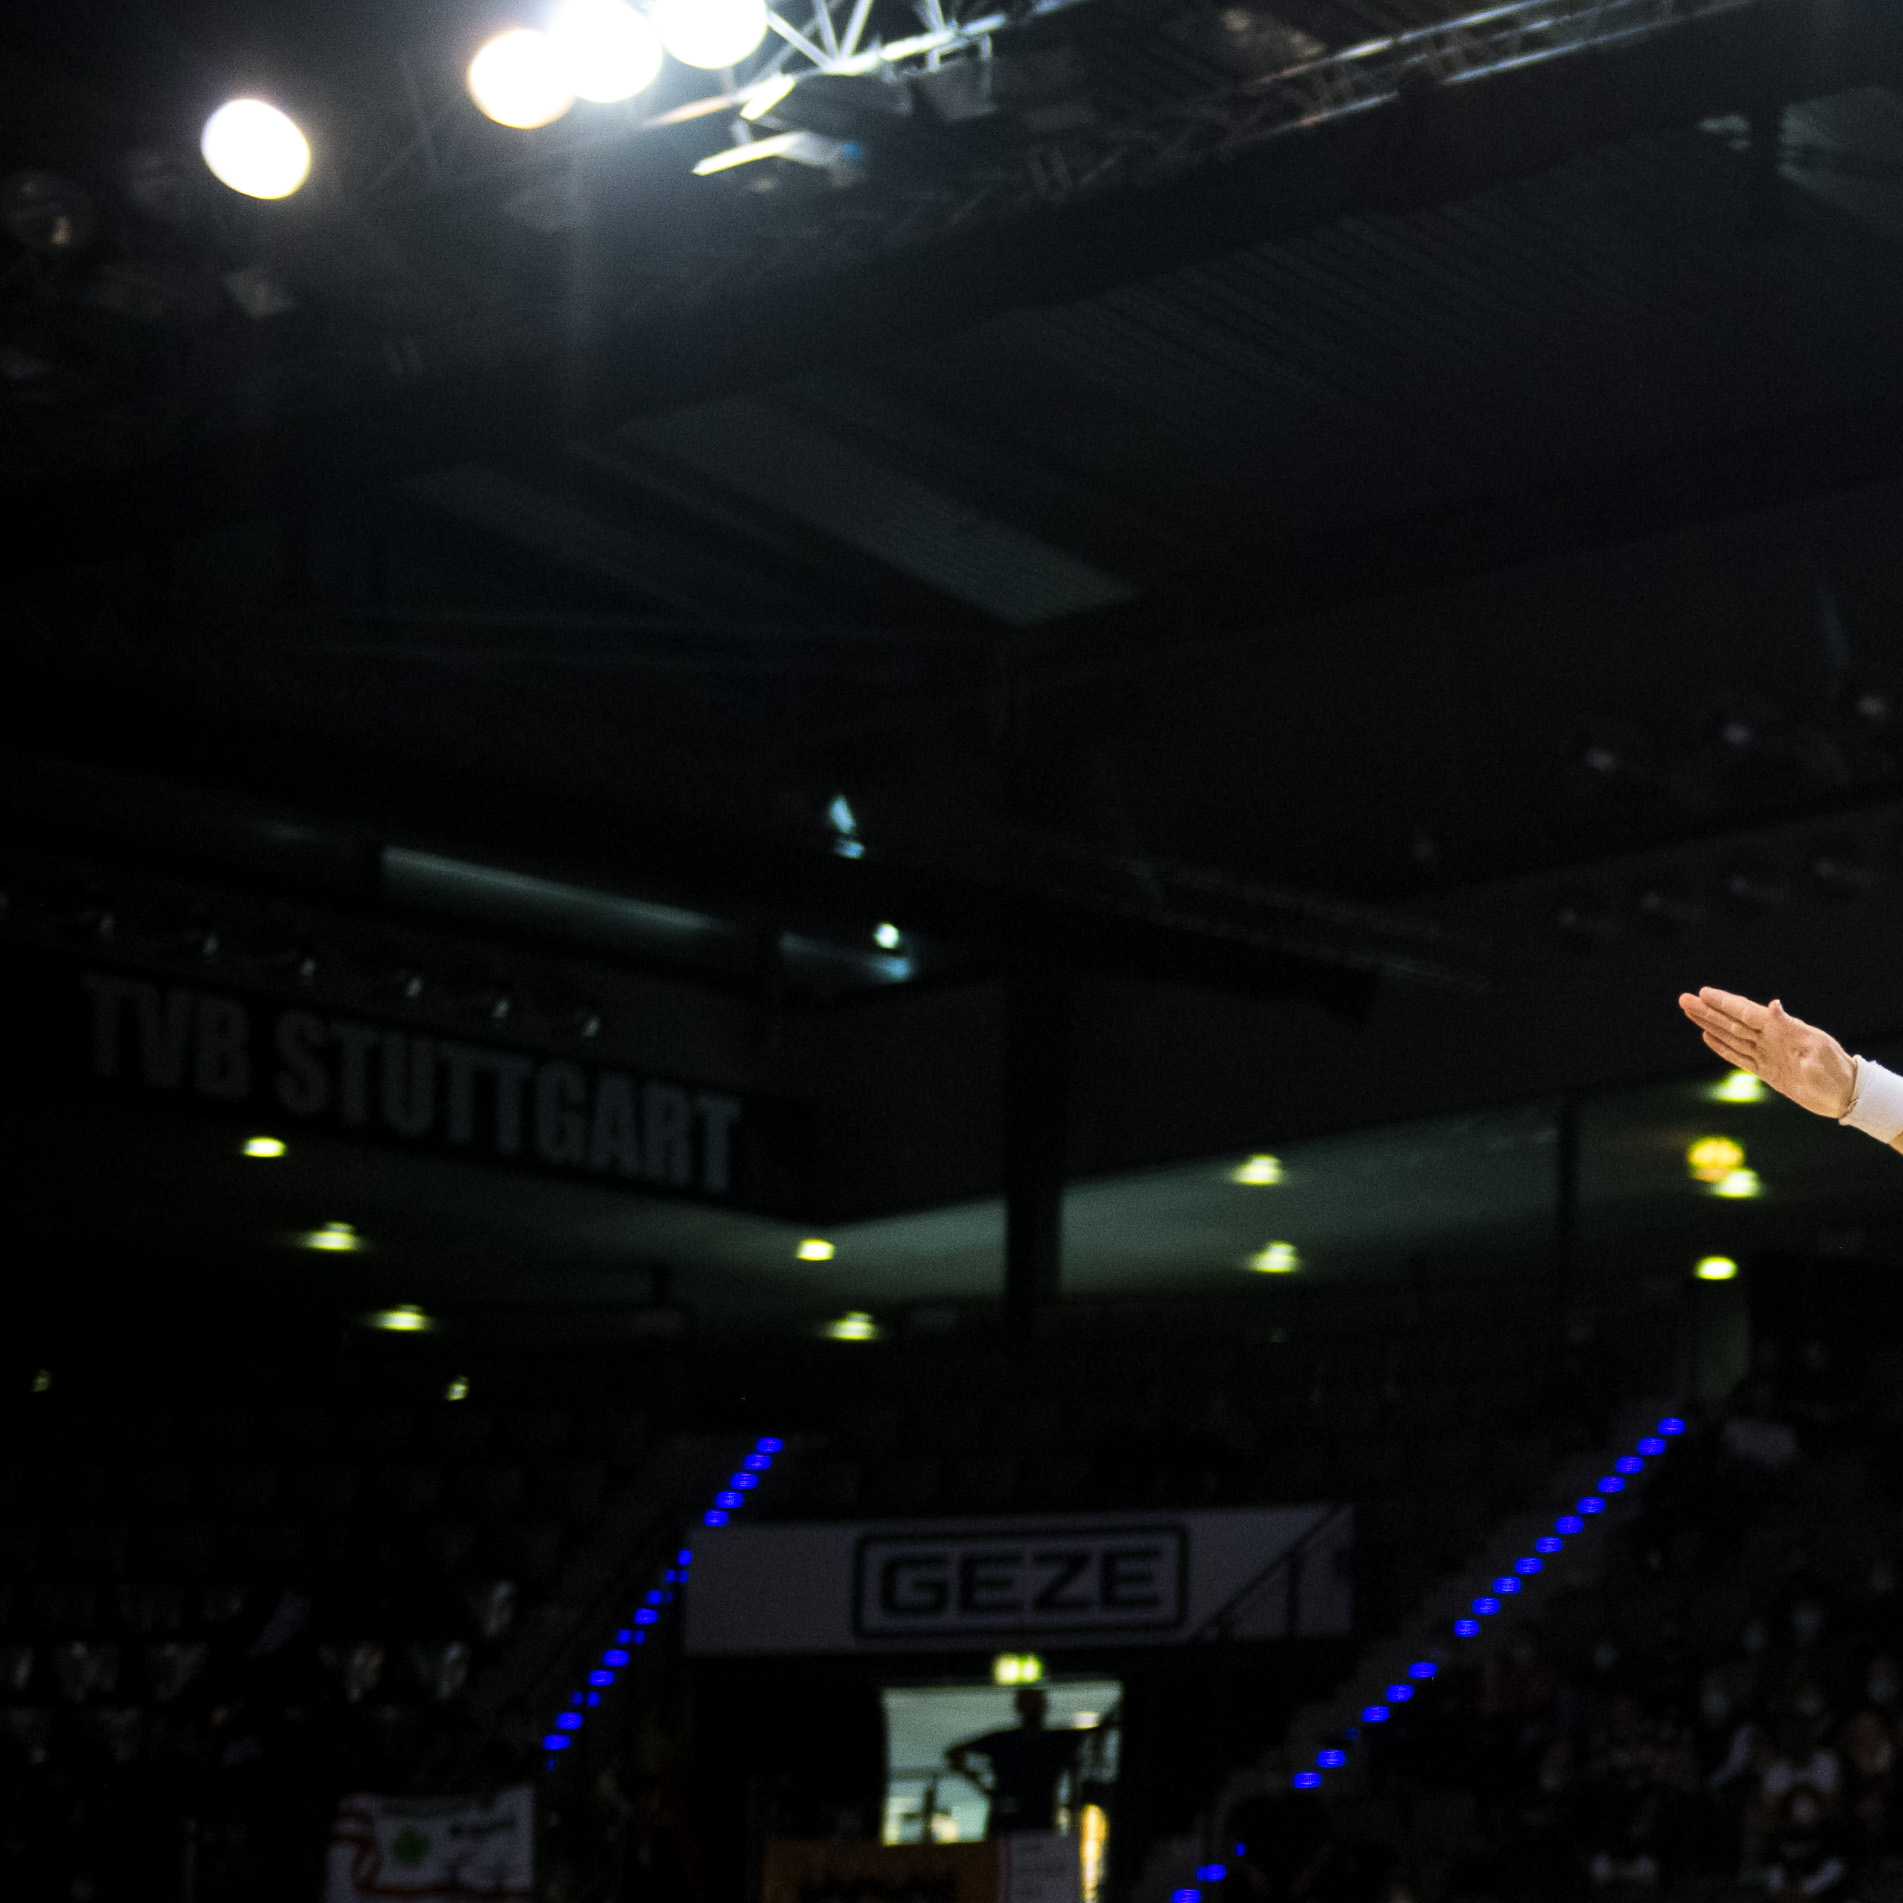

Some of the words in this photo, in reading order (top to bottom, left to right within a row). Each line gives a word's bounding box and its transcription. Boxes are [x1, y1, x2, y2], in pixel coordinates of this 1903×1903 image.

[79, 968, 253, 1103] TVB
[271, 1008, 743, 1195] STUTTGART
[882, 1546, 1162, 1614] GEZE
